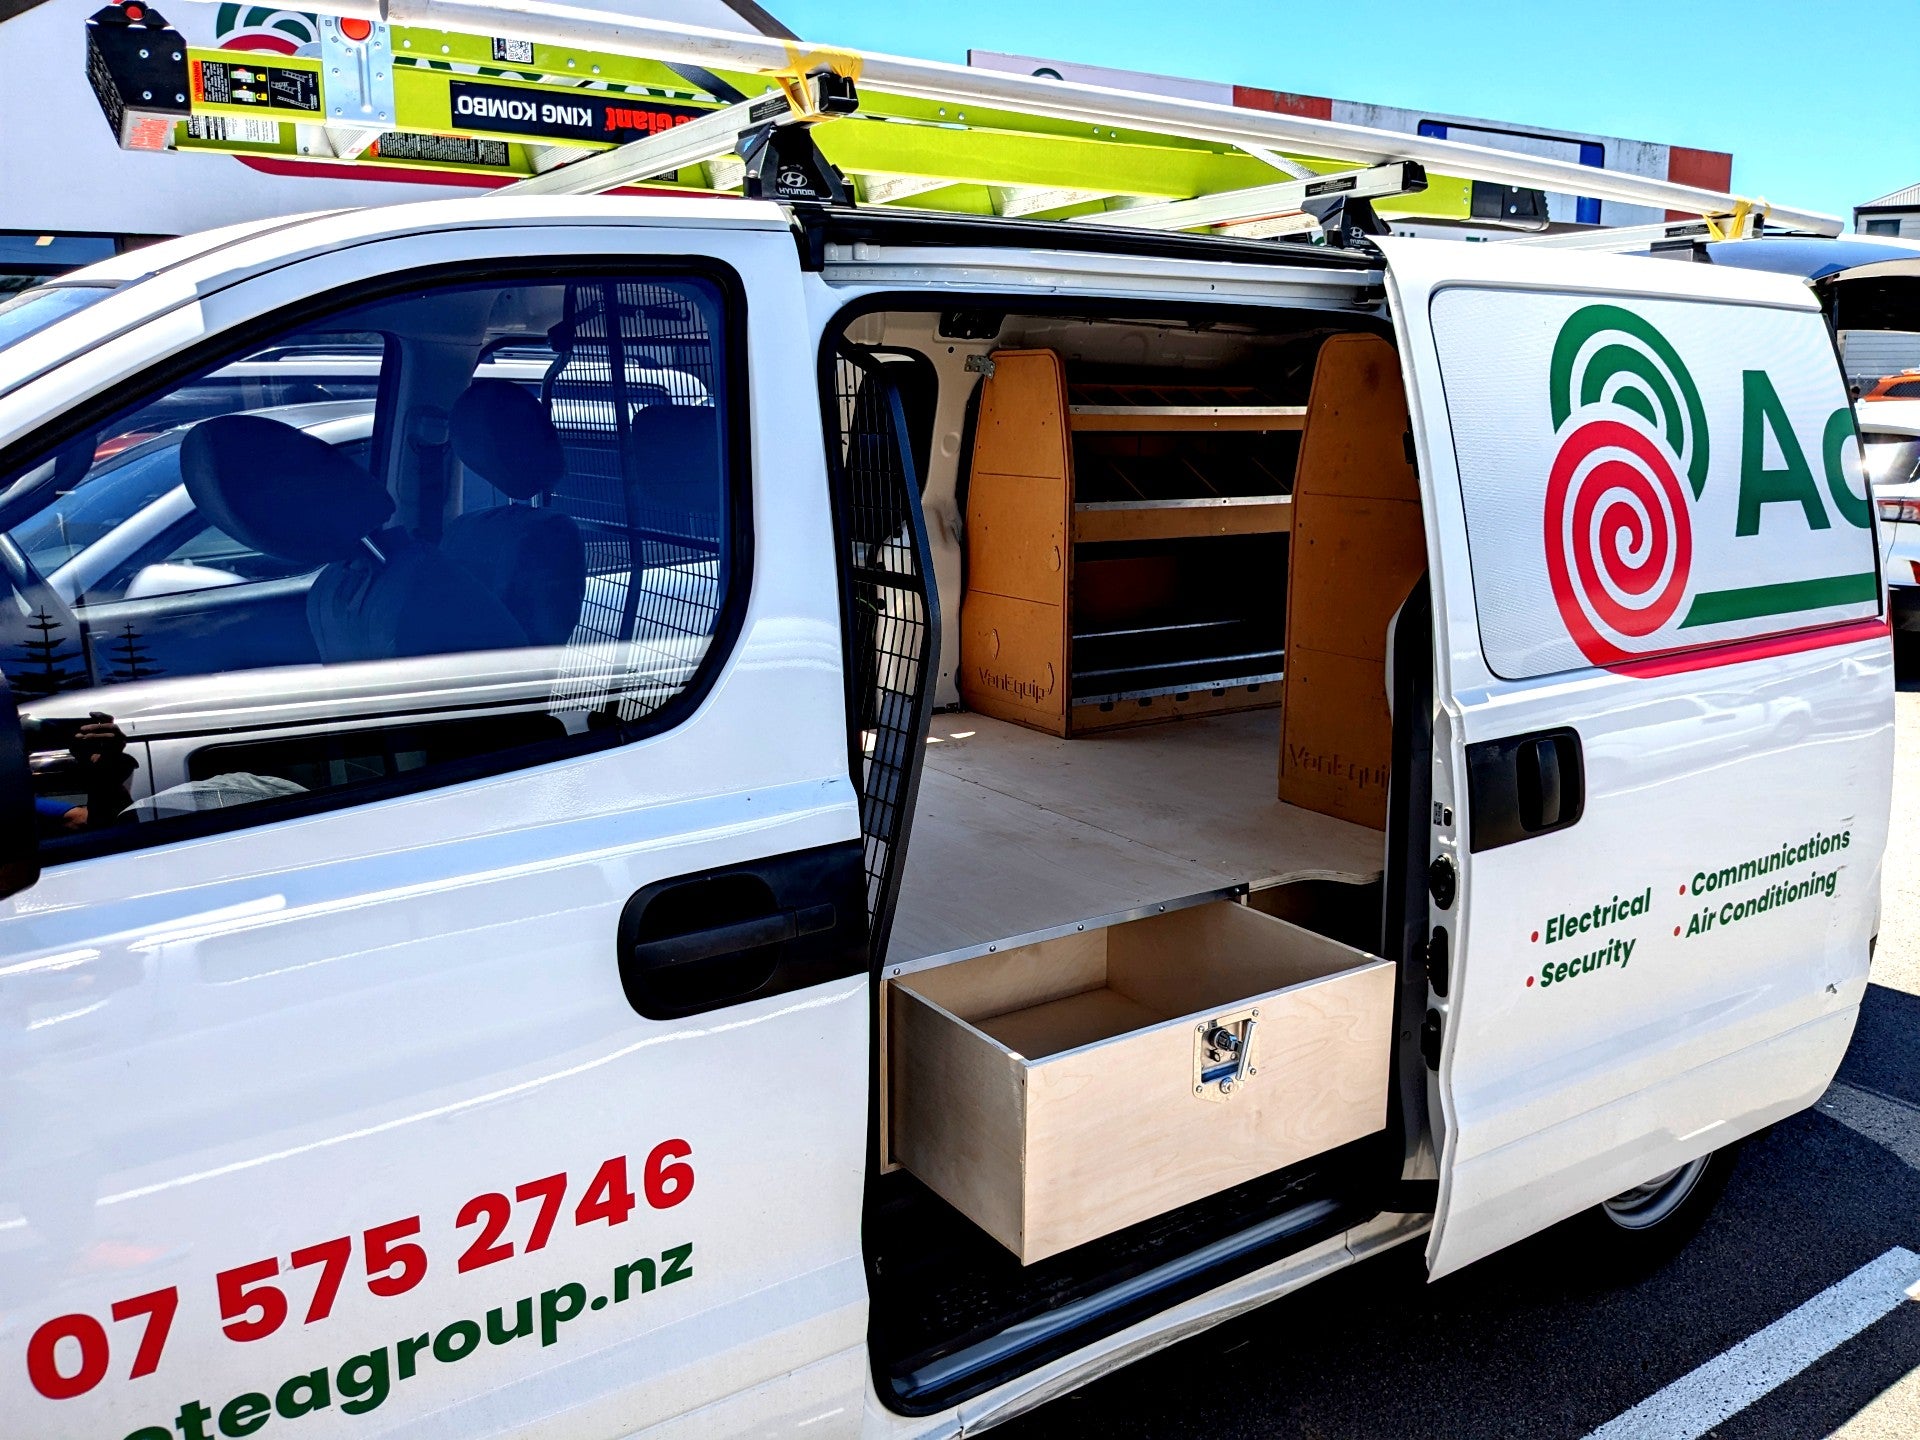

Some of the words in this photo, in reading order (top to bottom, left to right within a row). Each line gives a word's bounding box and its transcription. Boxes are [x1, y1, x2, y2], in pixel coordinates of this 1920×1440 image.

[457, 95, 537, 122] KOMBO
[541, 104, 593, 127] KING
[778, 186, 816, 196] HYUNDAI
[1289, 743, 1387, 789] VanEqui
[1691, 829, 1850, 896] Communications
[1545, 887, 1651, 944] Electrical
[1685, 906, 1717, 938] Air
[1719, 868, 1838, 925] Conditioning
[1540, 937, 1636, 988] Security
[27, 1286, 179, 1400] 07
[216, 1215, 428, 1342] 575
[455, 1138, 695, 1274] 2746
